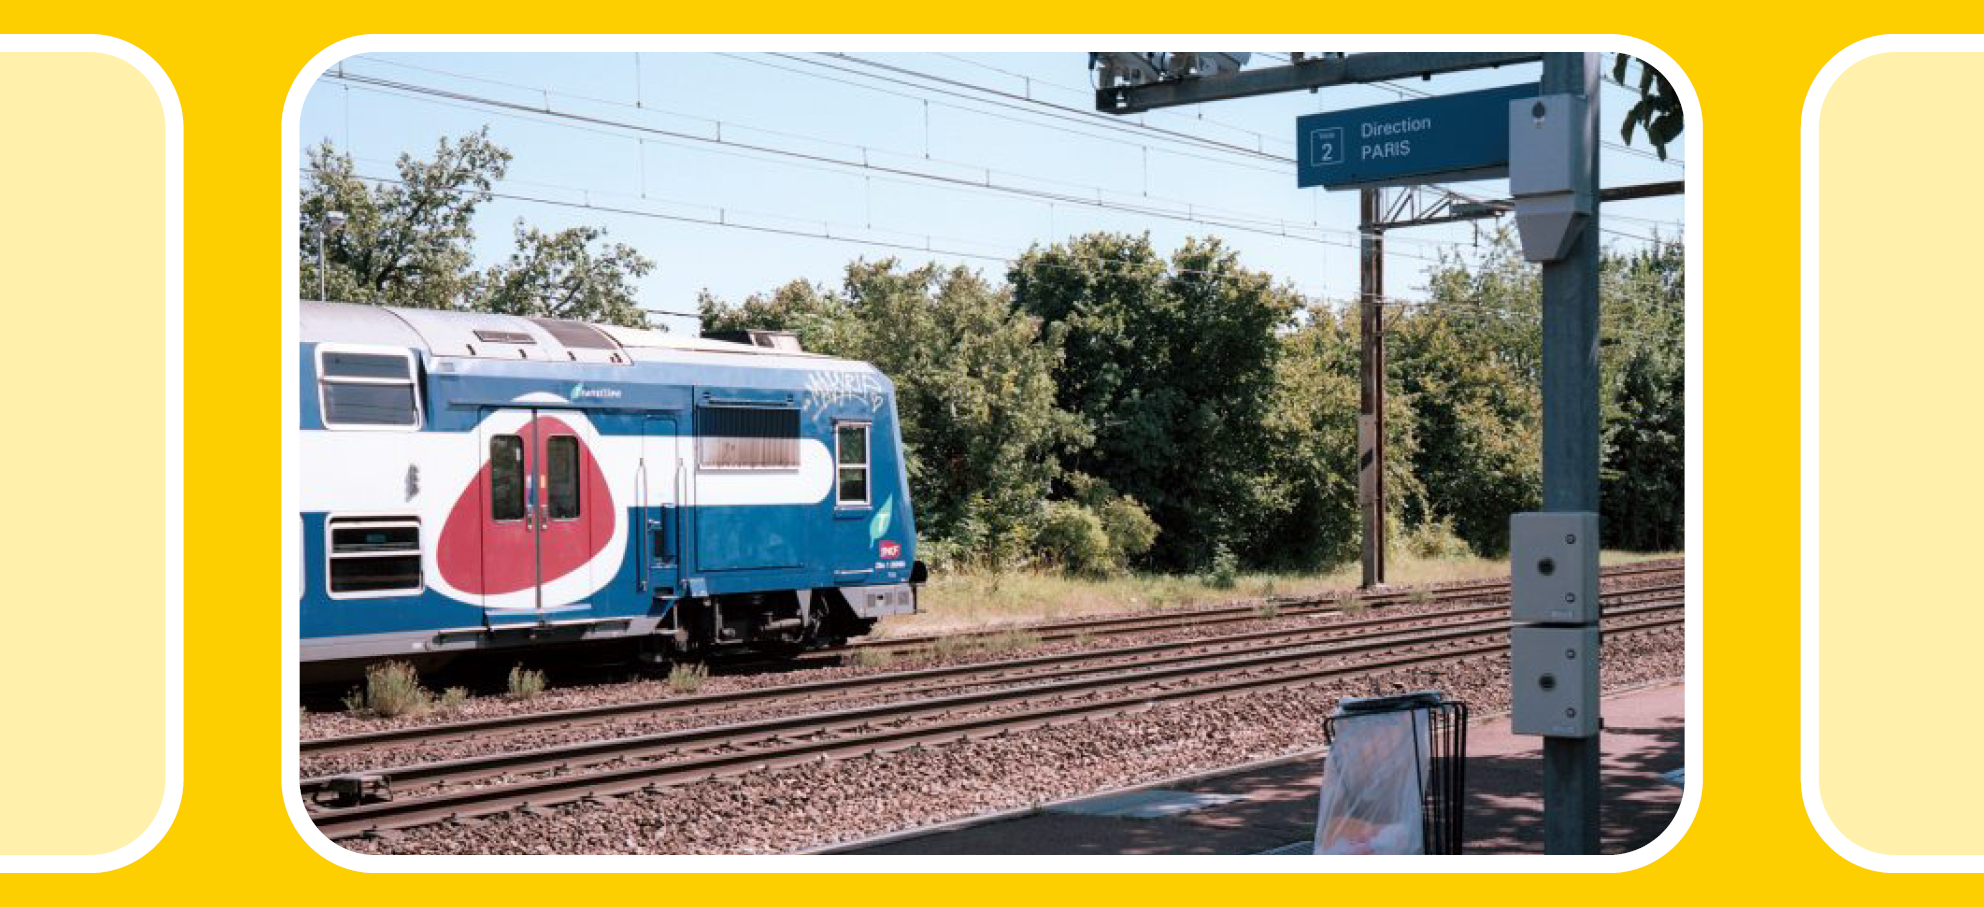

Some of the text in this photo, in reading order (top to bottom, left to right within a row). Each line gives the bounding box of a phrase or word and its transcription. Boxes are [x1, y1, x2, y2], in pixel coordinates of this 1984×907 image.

[1361, 117, 1432, 139] Direction
[1321, 143, 1333, 162] 2
[1361, 139, 1411, 160] PARIS
